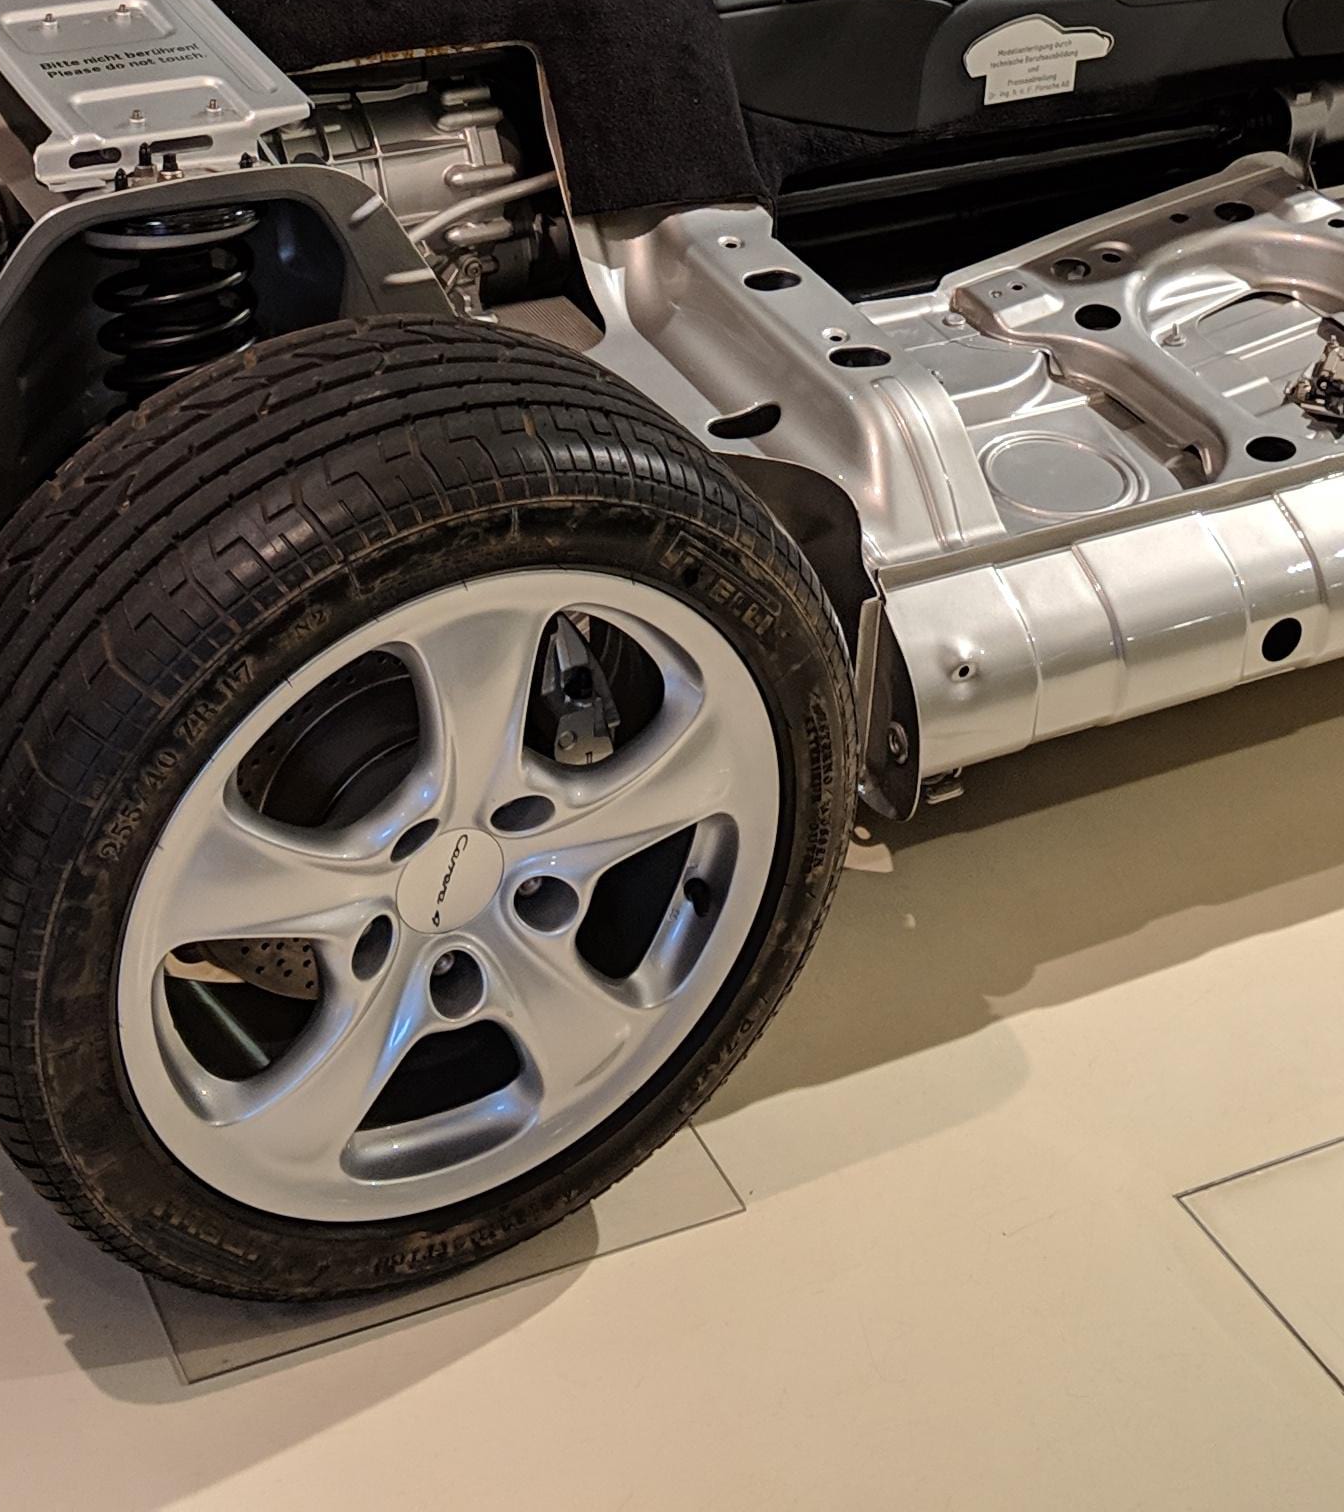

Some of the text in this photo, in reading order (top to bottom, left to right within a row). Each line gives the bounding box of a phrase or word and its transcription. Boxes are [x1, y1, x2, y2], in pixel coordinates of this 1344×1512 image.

[39, 59, 81, 71] Bitte
[83, 53, 124, 65] nicht
[46, 65, 102, 79] Please
[105, 62, 125, 70] do
[128, 59, 156, 68] not
[98, 658, 257, 862] 255/40 ZR 17
[431, 833, 469, 928] Carrera 4
